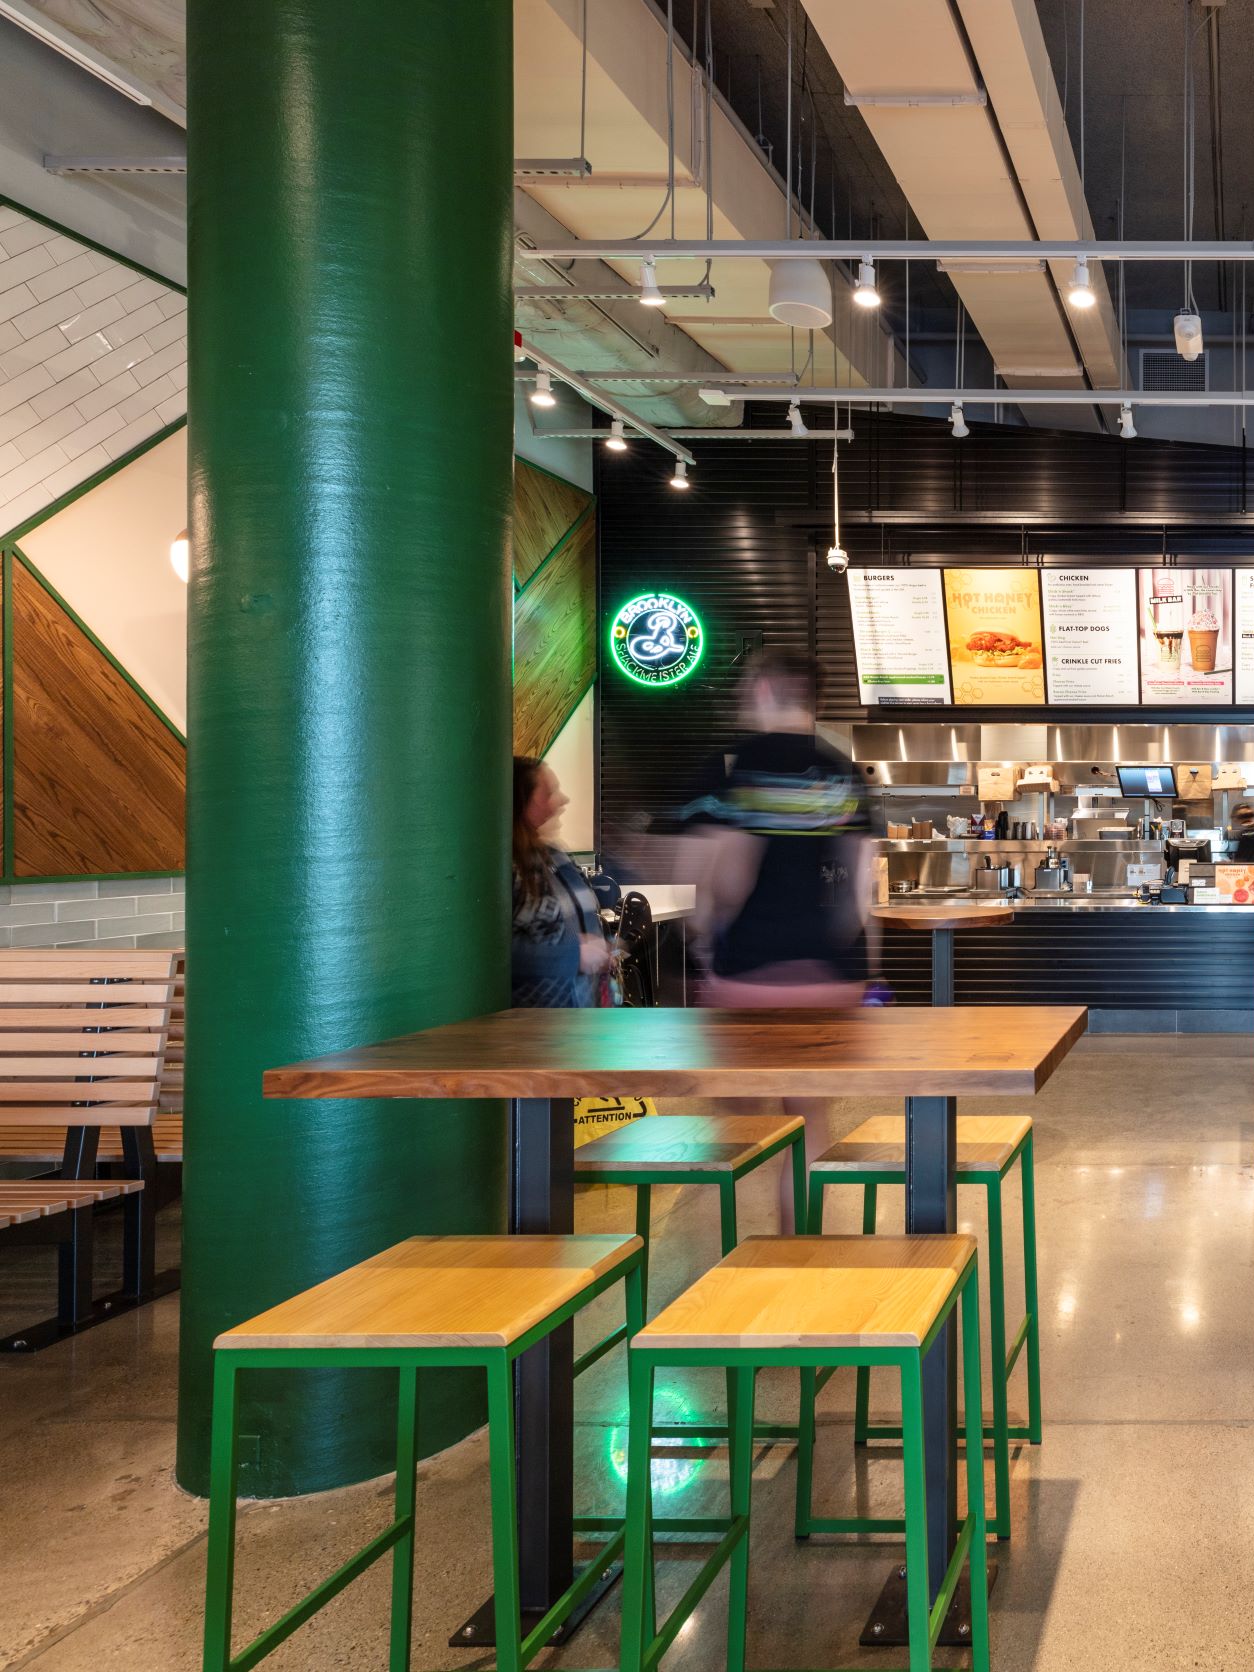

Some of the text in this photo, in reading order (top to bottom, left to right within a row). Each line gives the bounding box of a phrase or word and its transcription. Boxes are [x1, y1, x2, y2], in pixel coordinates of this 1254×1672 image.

[951, 592, 981, 608] HOT
[983, 592, 1033, 608] HONEY
[1150, 595, 1183, 605] MILK BAR
[620, 597, 693, 625] BROOKLYN
[971, 606, 1017, 615] CHICKEN
[615, 642, 700, 684] SHACKMEISTER ALE
[578, 1112, 632, 1124] ATTENTION
